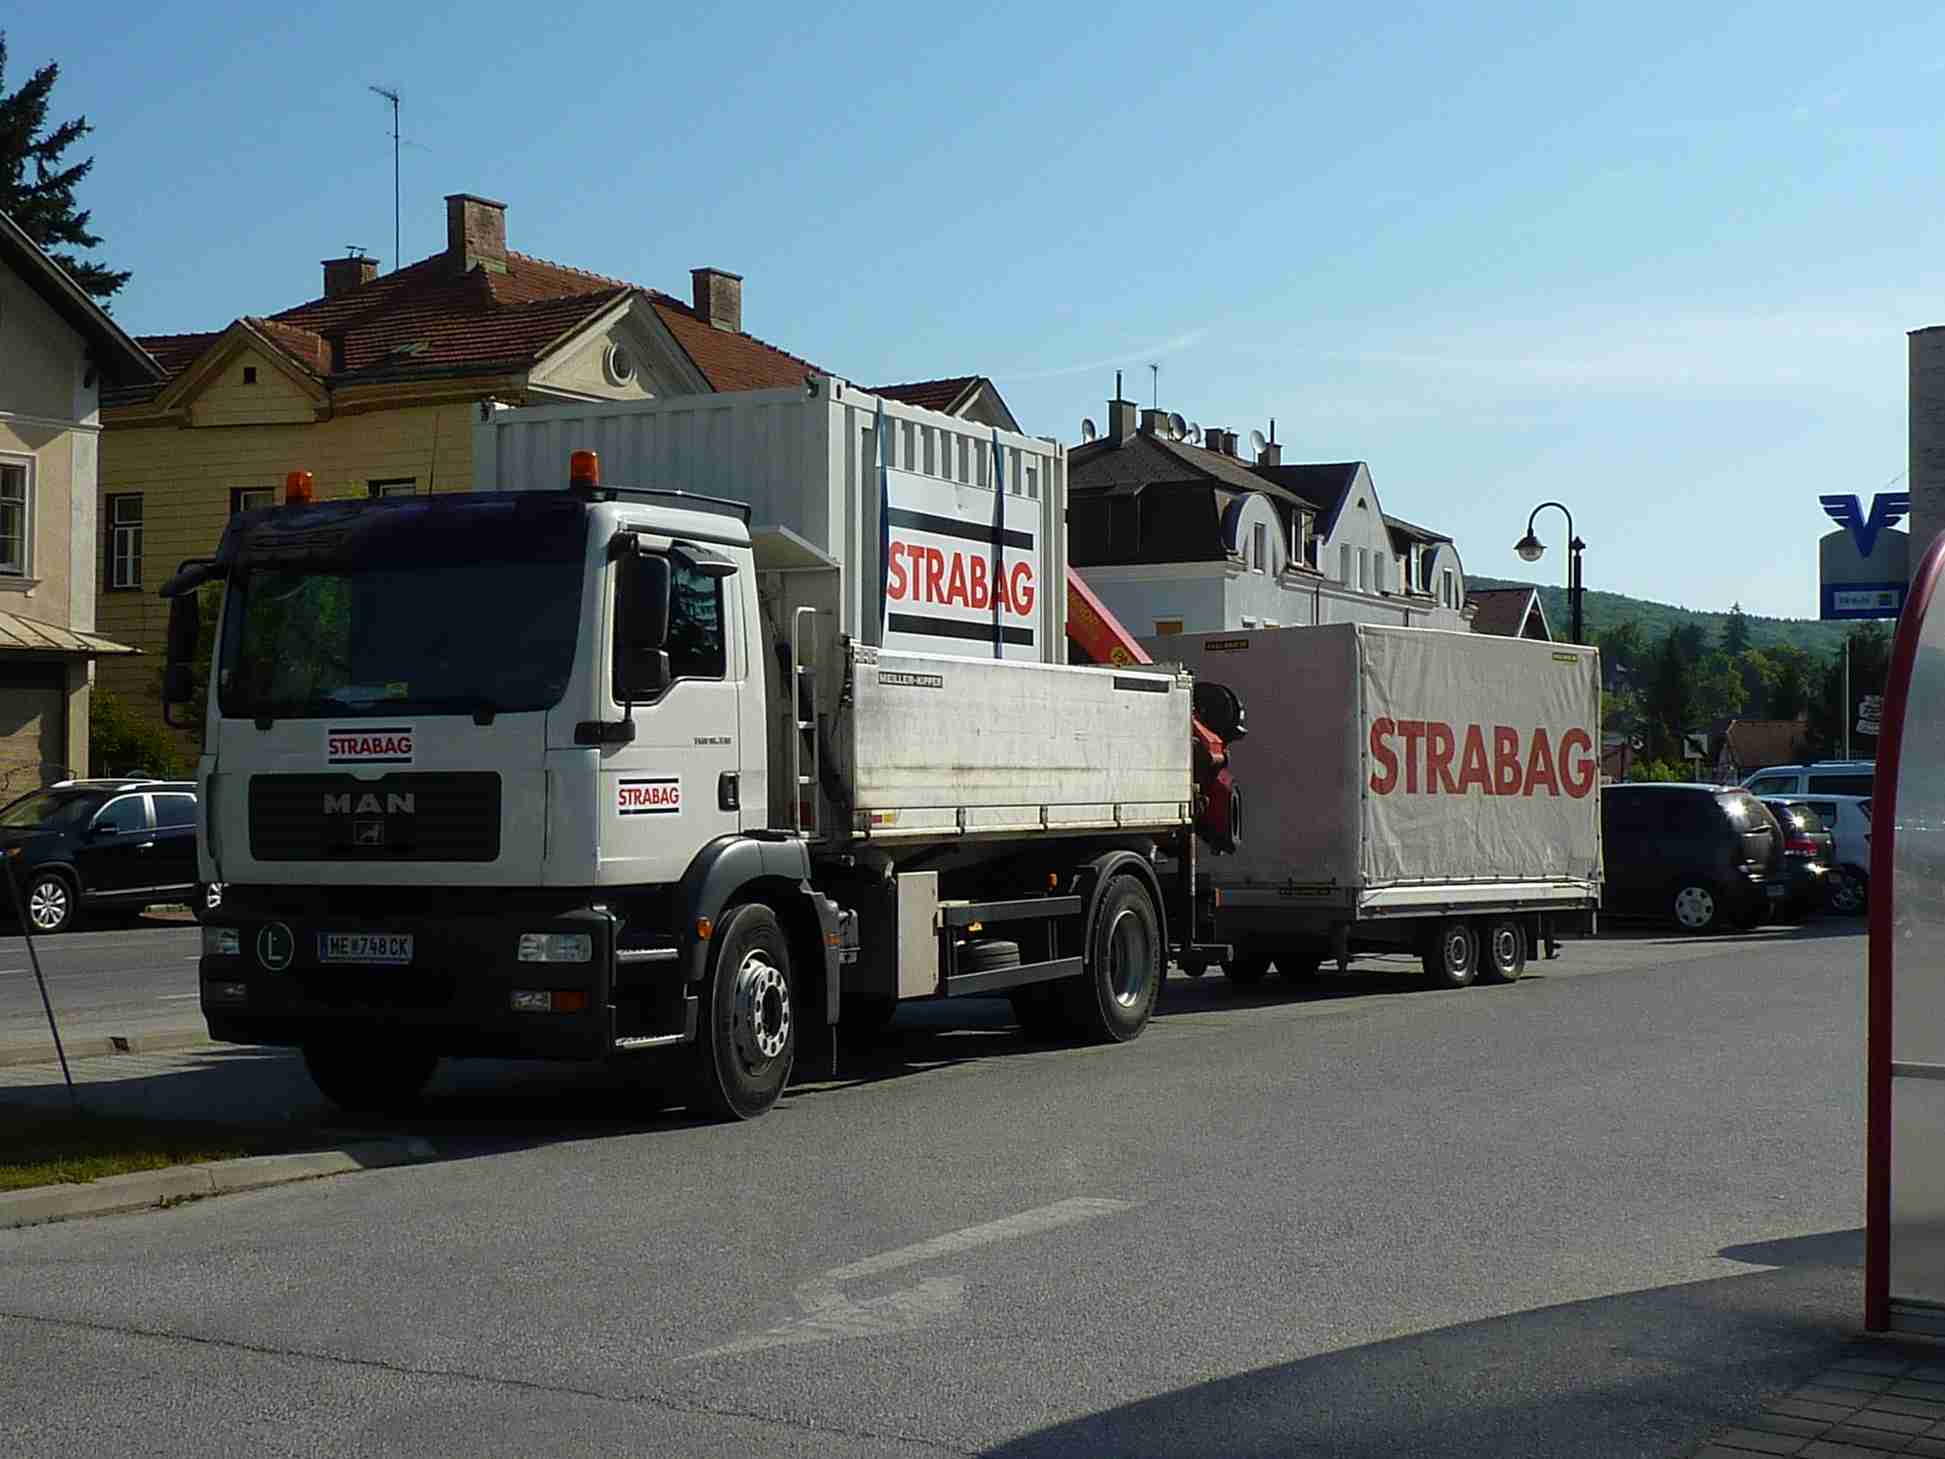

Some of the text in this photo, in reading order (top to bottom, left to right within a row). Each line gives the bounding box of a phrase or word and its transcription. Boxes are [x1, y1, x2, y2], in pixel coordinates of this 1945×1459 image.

[887, 540, 1035, 616] STRABAG
[328, 736, 412, 755] STRABAG
[1369, 717, 1596, 799] STRABAG
[323, 792, 416, 814] MAN
[618, 787, 679, 805] STRABAG
